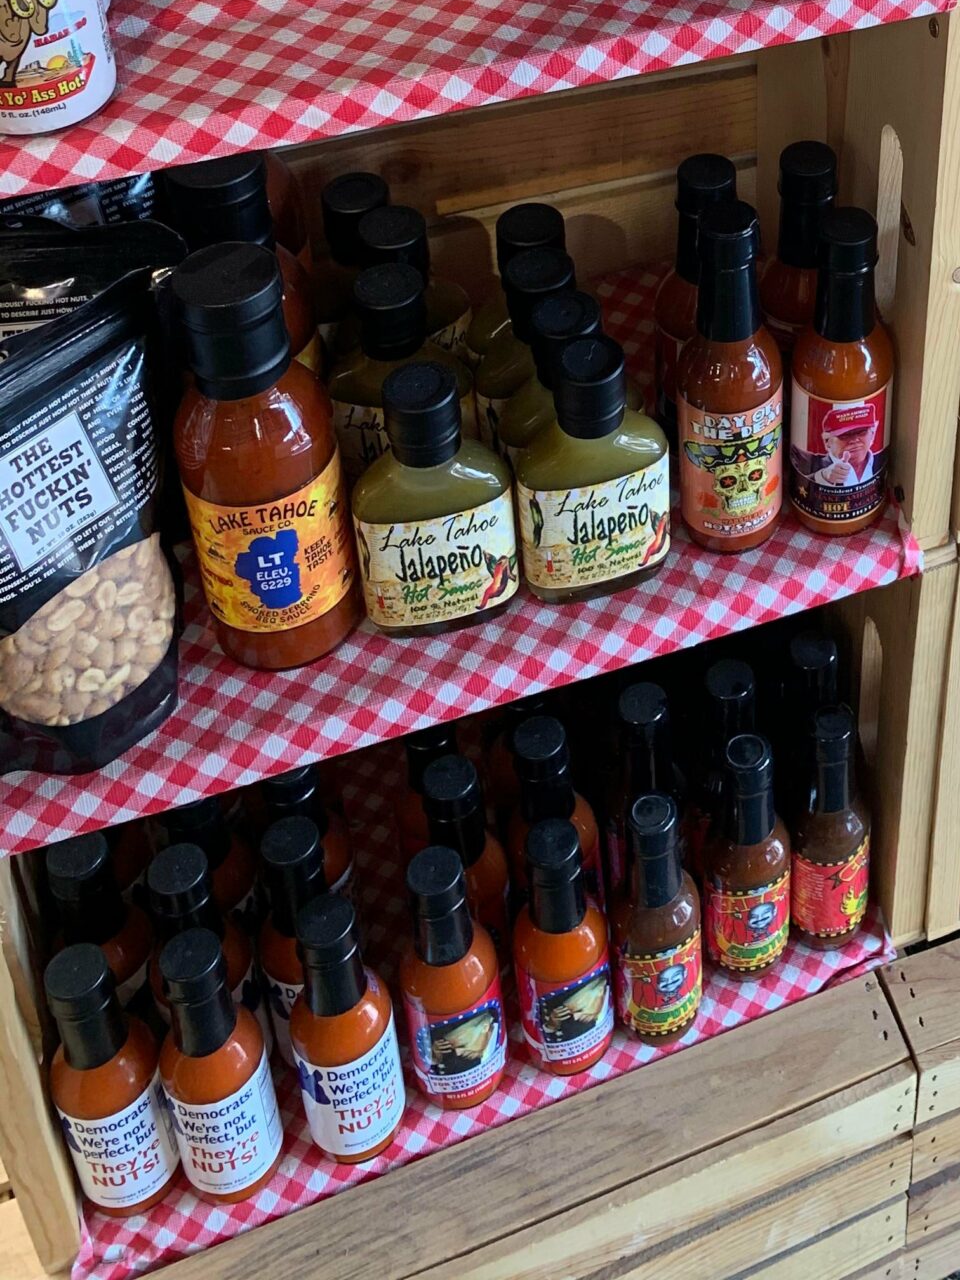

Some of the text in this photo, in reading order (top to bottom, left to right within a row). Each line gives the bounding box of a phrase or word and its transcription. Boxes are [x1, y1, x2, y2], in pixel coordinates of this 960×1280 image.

[31, 89, 56, 103] Ass
[49, 399, 61, 409] HOT
[38, 415, 51, 428] JUST
[690, 422, 734, 440] THE
[704, 414, 747, 428] DAY
[9, 437, 53, 473] THE
[5, 459, 92, 532] FUCKIN'
[554, 472, 664, 516] Lake Tahoe
[26, 488, 93, 544] NUTS
[209, 500, 318, 534] LAKE TAHOE
[243, 520, 294, 536] SAUCE CO.
[73, 528, 93, 545] TO LET
[78, 525, 115, 552] THERE NO
[379, 512, 499, 551] Lake Tahoe
[304, 536, 326, 555] KEEP
[304, 540, 333, 563] TAHOE
[571, 545, 601, 566] Hot
[257, 552, 285, 569] LT
[609, 552, 641, 568] Natural
[260, 578, 292, 591] 6229
[402, 581, 432, 604] Hot
[444, 594, 479, 609] Natural
[329, 1056, 390, 1096] We're not
[332, 1061, 395, 1109] perfect, but
[73, 1096, 152, 1135] Democrats:
[177, 1088, 254, 1120] Democrats:
[78, 1120, 147, 1148] We're not
[181, 1110, 247, 1133] We're not
[186, 1114, 257, 1144] perfect, but
[83, 1122, 157, 1159] perfect, but
[189, 1131, 260, 1159] They're
[87, 1138, 161, 1173] They're
[192, 1146, 258, 1174] NUTS!
[91, 1153, 160, 1188] NUTS!
